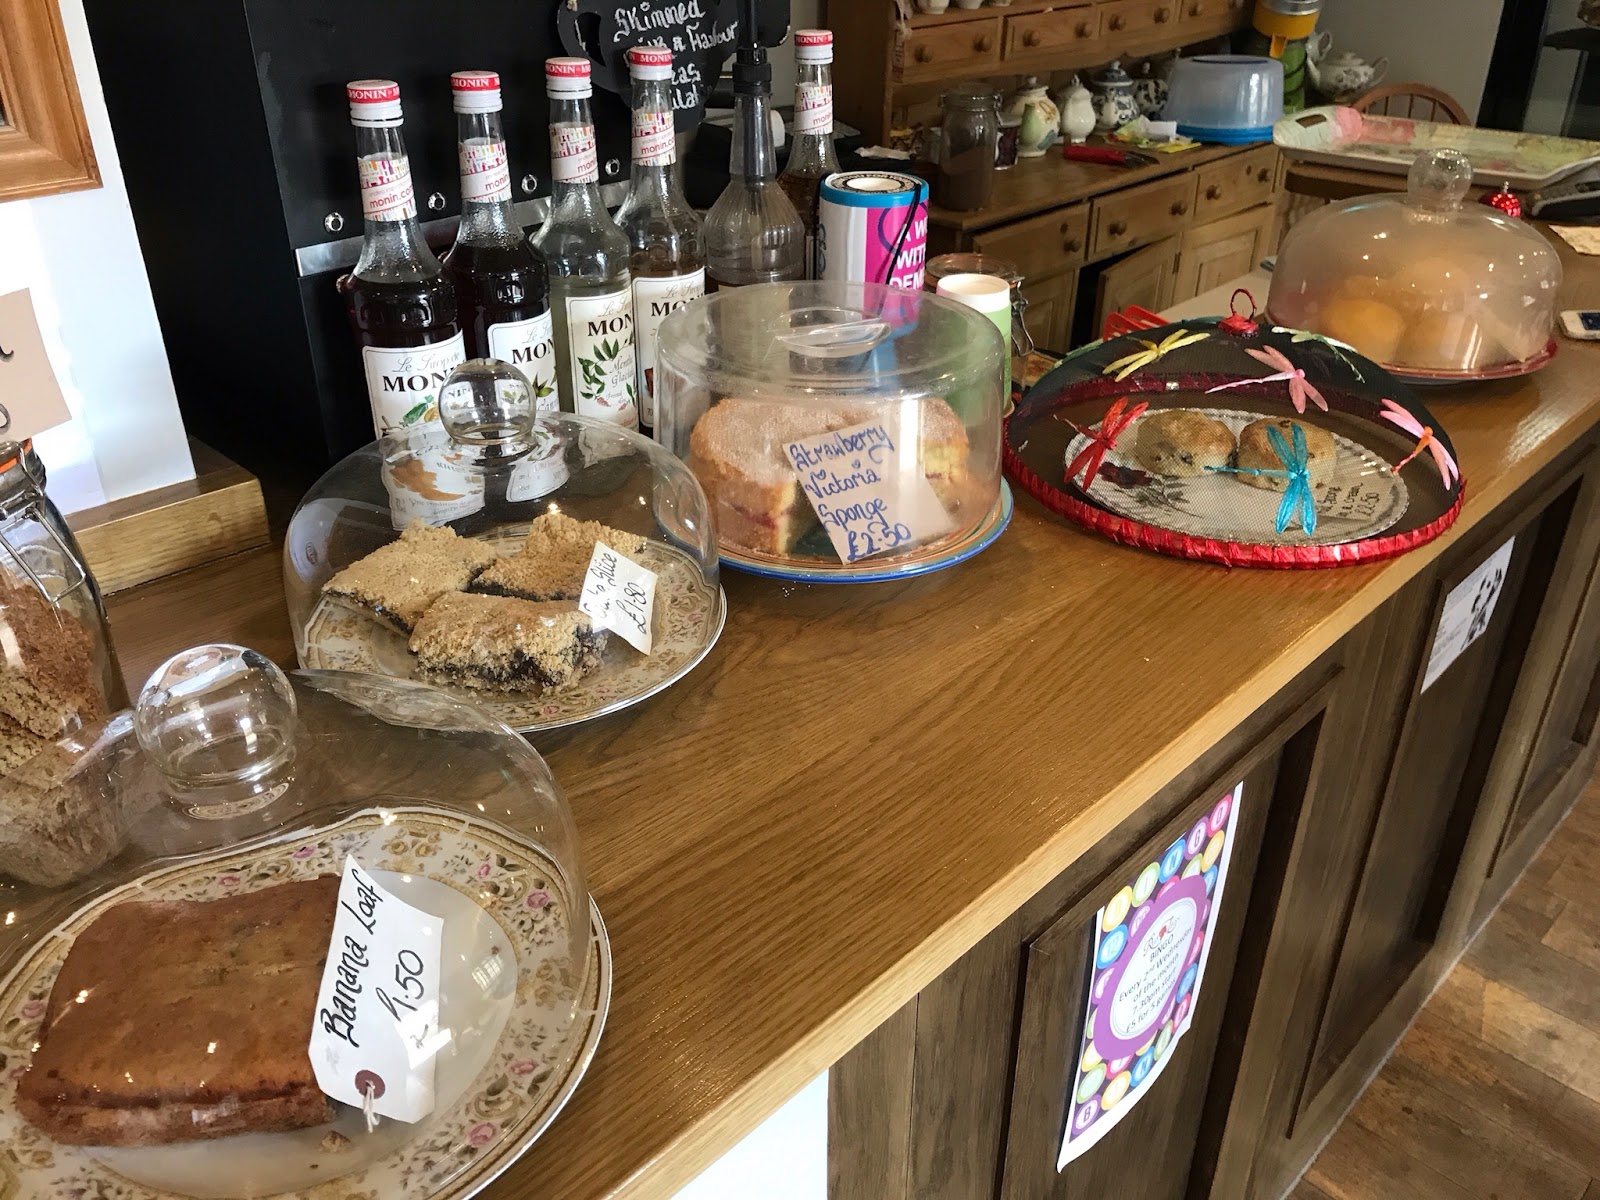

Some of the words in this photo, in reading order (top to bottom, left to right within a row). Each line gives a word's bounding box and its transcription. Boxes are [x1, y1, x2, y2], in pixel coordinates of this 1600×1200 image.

[789, 425, 895, 473] Strawberry
[805, 459, 882, 499] Victoria
[818, 498, 889, 534] Sponge
[341, 868, 384, 935] Loaf
[320, 935, 369, 1048] Banana
[1119, 981, 1141, 1002] Every
[1143, 979, 1156, 994] the
[1157, 952, 1180, 980] month
